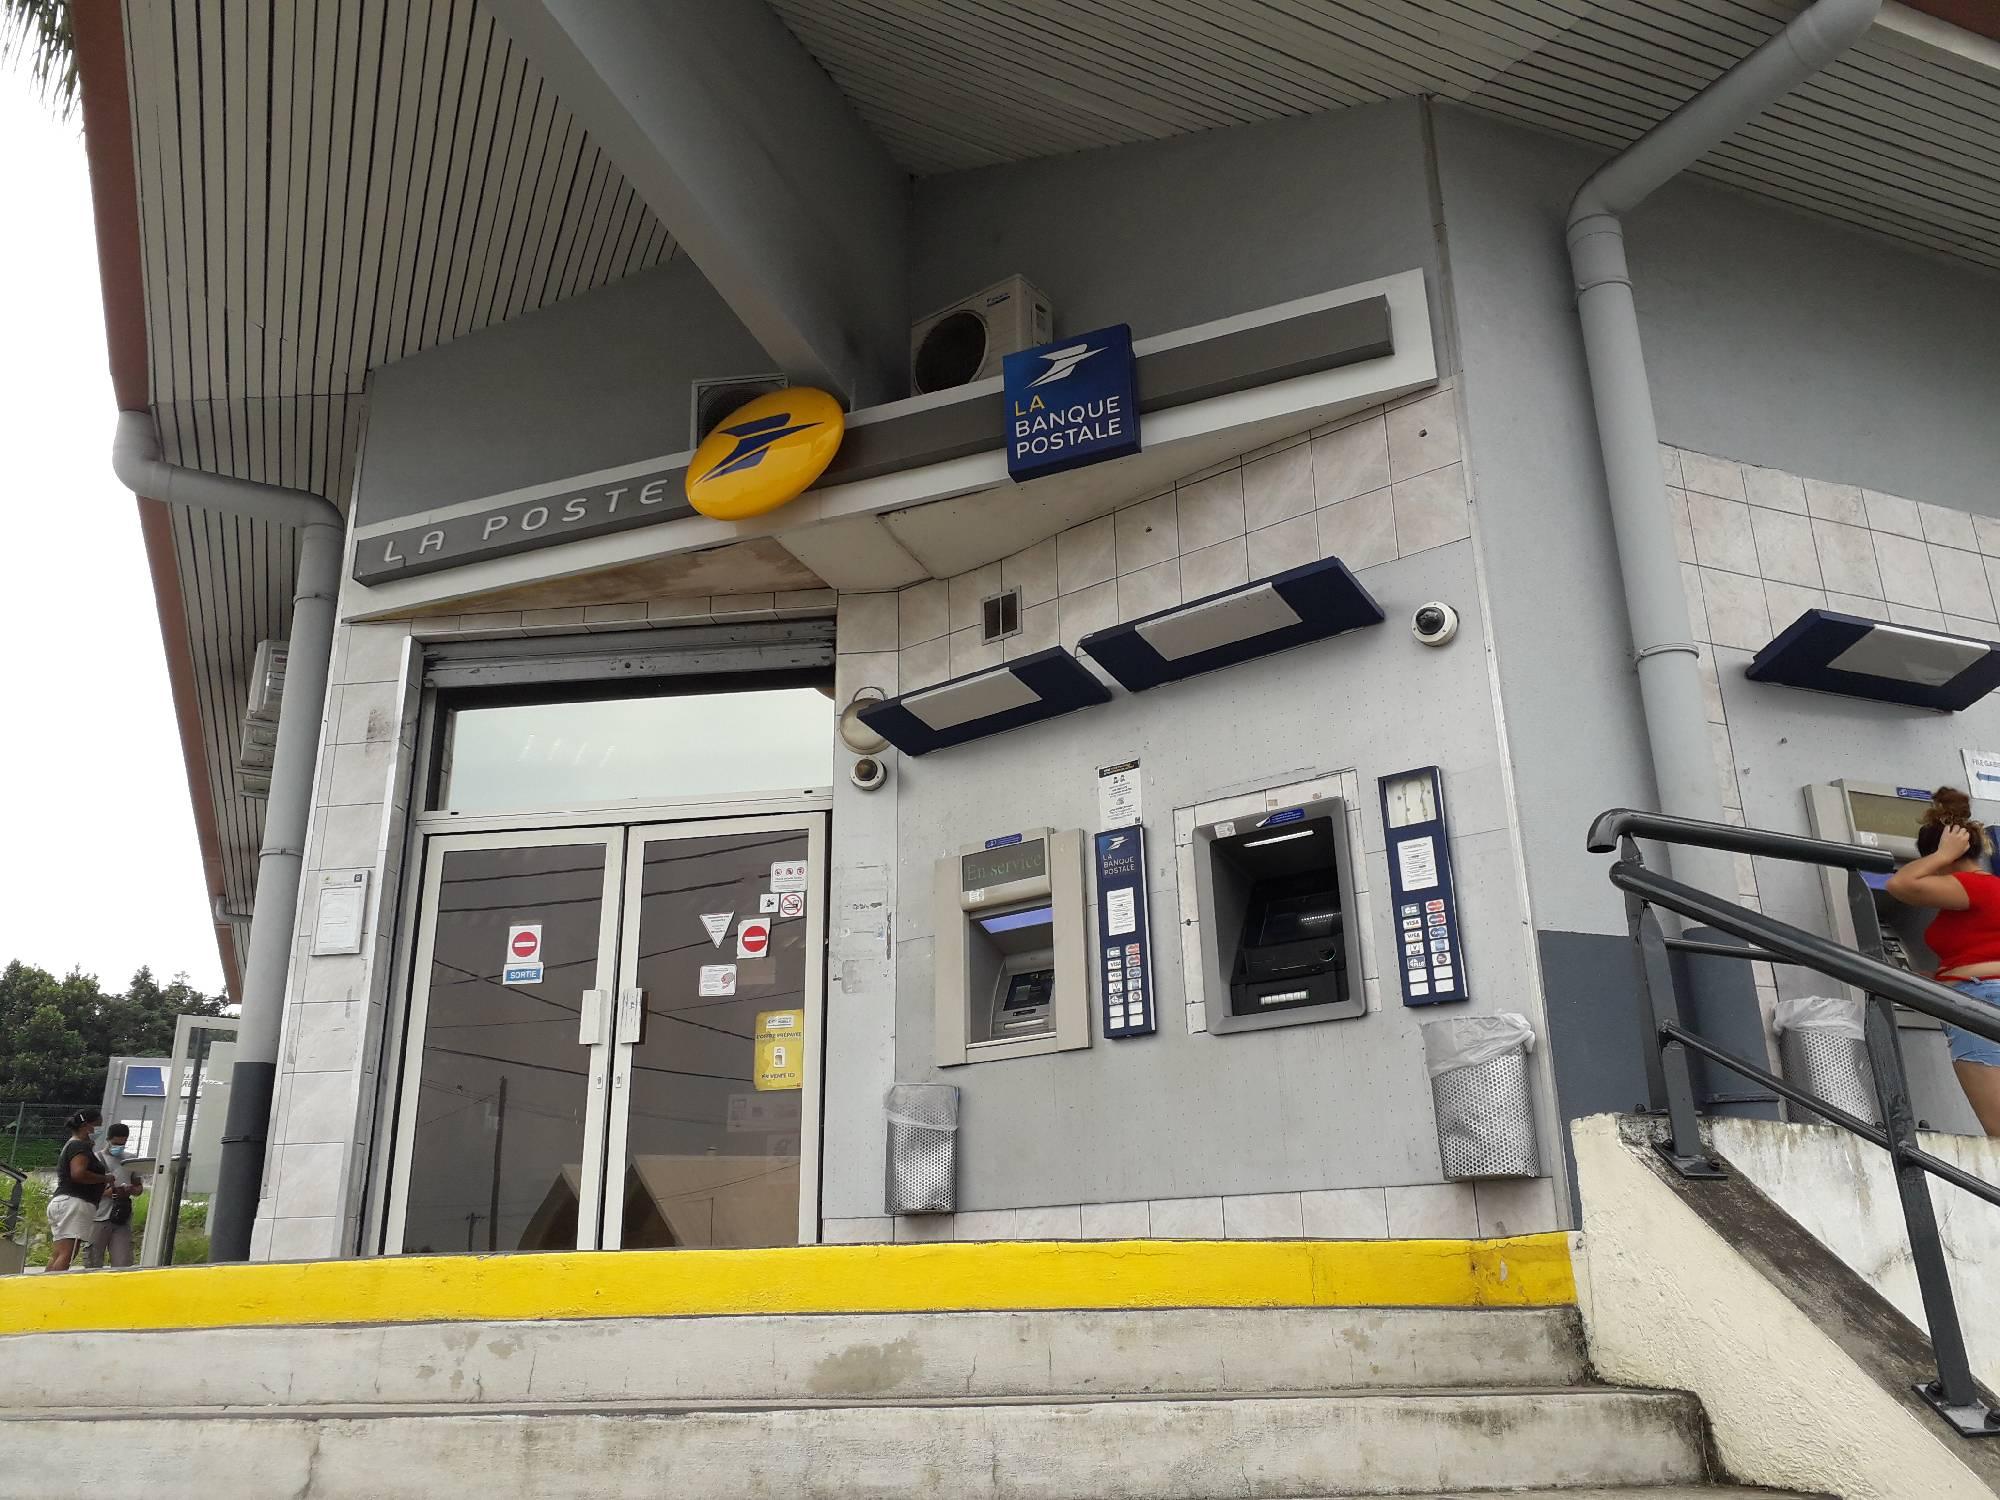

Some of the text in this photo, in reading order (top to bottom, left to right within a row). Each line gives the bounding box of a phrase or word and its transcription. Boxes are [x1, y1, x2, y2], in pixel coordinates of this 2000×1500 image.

[1015, 394, 1045, 417] LA
[1016, 396, 1121, 438] BANQUE
[1016, 417, 1122, 460] POSTALE
[383, 480, 668, 563] LA POSTE
[967, 853, 1042, 881] En service
[1103, 853, 1112, 861] LA
[1104, 856, 1134, 868] BANQUE
[1104, 864, 1135, 876] POSTALE
[510, 970, 537, 979] SORTIE
